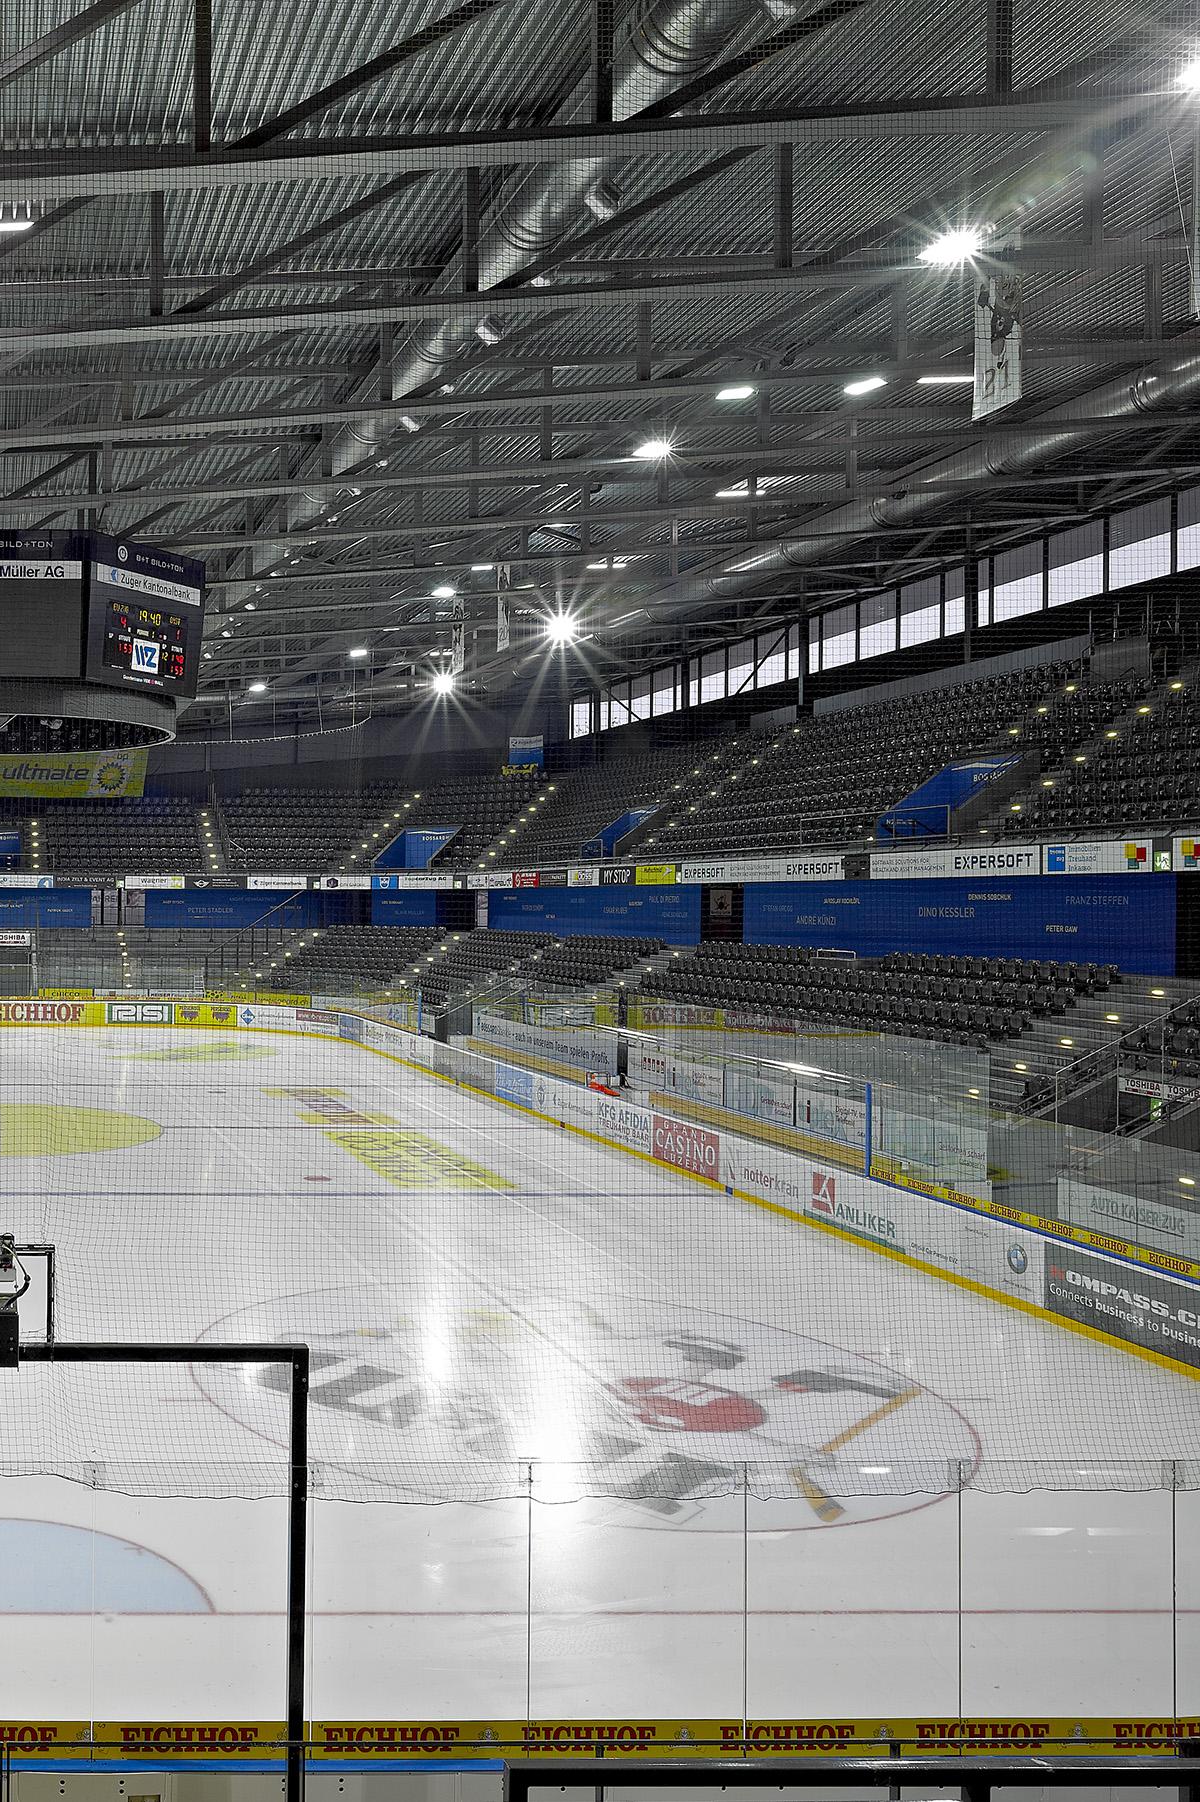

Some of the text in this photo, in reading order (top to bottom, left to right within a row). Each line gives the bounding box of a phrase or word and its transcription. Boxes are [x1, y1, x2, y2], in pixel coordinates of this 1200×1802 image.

[0, 564, 41, 578] Müller
[44, 566, 65, 578] AG
[120, 574, 191, 600] Zuger Kantonalbank
[2, 762, 89, 780] ultimate
[786, 862, 840, 876] EXPERSOFT
[954, 853, 1034, 869] EXPERSOFT
[603, 869, 614, 883] MY
[614, 869, 631, 883] STOP
[684, 867, 725, 879] EXPERSOFT
[1065, 896, 1129, 905] FRANZ STEFFEN
[817, 914, 837, 925] KÜNZI
[919, 906, 975, 918] DINO KESSLER
[1045, 924, 1078, 933] PETER GAW
[1125, 1079, 1161, 1091] TOSHIBA
[618, 1107, 649, 1133] AFIDIA
[663, 1119, 708, 1142] GRAND
[655, 1129, 716, 1167] CASINO
[663, 1150, 707, 1174] LUZERN
[743, 1165, 799, 1198] notterkran
[907, 1178, 935, 1194] EICHHOF
[948, 1190, 977, 1207] EICHHOF
[1090, 1196, 1119, 1215] AUTO
[835, 1203, 897, 1239] ANLIKER
[989, 1203, 1022, 1221] EICHHOF
[1038, 1218, 1075, 1239] EICHHOF
[1089, 1234, 1129, 1255] EICHHOF
[1148, 1252, 1193, 1275] EICHHOF
[1050, 1283, 1200, 1349] Connects business to busin
[120, 1727, 258, 1753] EICHHOF
[323, 1727, 460, 1752] EICHHOF
[521, 1726, 656, 1752] EICHHOF
[719, 1725, 854, 1751] EICHHOF
[916, 1724, 1050, 1749] EICHHOF
